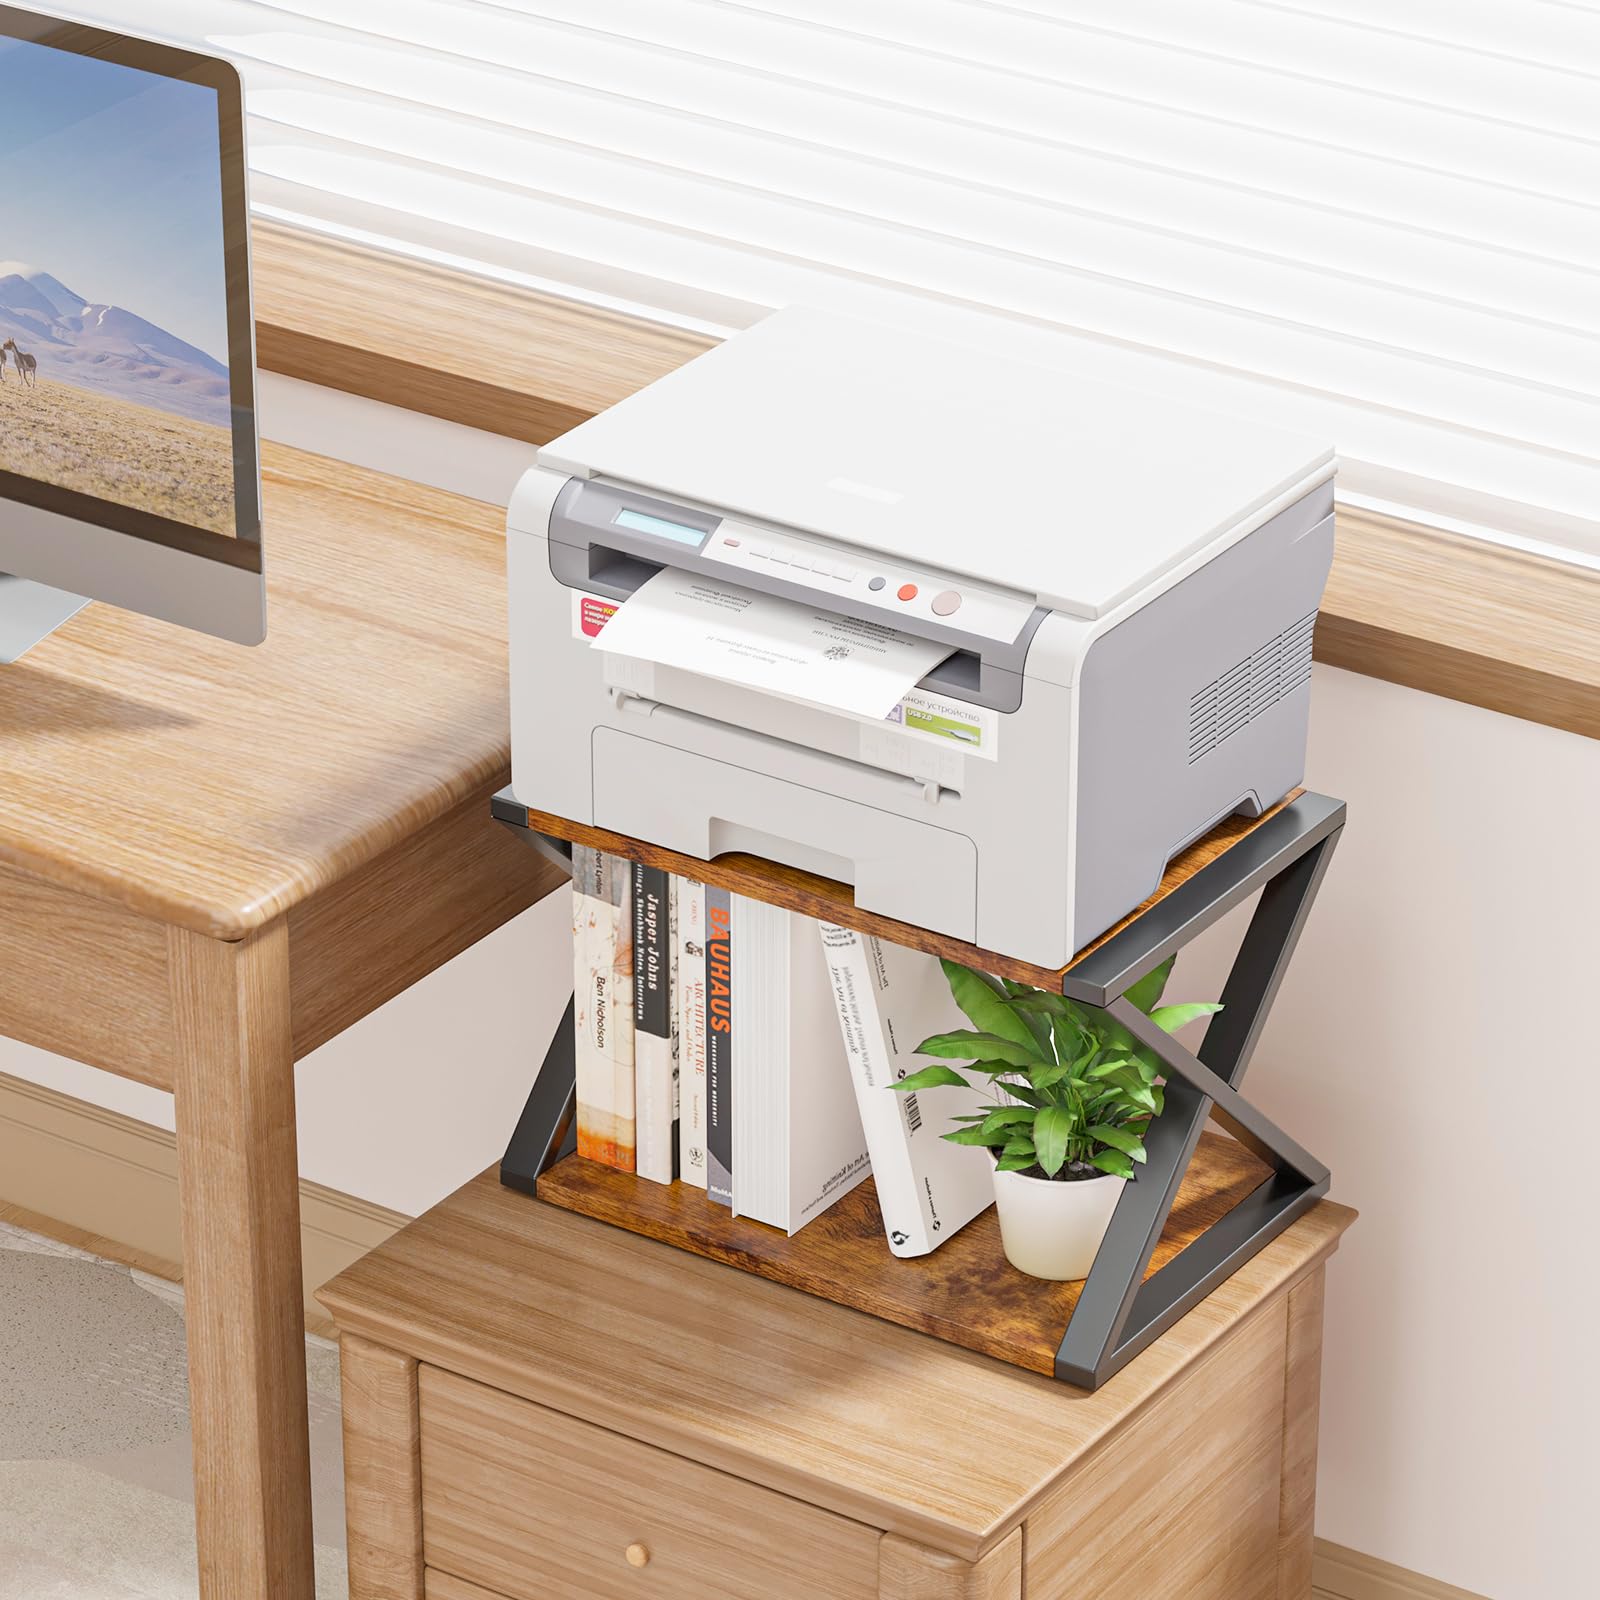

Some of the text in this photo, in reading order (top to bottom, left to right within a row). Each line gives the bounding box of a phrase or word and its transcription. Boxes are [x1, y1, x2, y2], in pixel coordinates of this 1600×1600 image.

[908, 710, 922, 719] USB
[922, 713, 932, 721] 2.0
[926, 701, 980, 722] устройство
[595, 870, 604, 895] Lynton
[636, 898, 645, 945] Sketchbook
[645, 894, 660, 991] Jasper Johns
[709, 907, 730, 1034] BAUHAUS
[596, 976, 606, 1049] Ben Nicholson
[637, 976, 645, 1020] Interviews
[694, 978, 705, 1076] ARCHITECTURE
